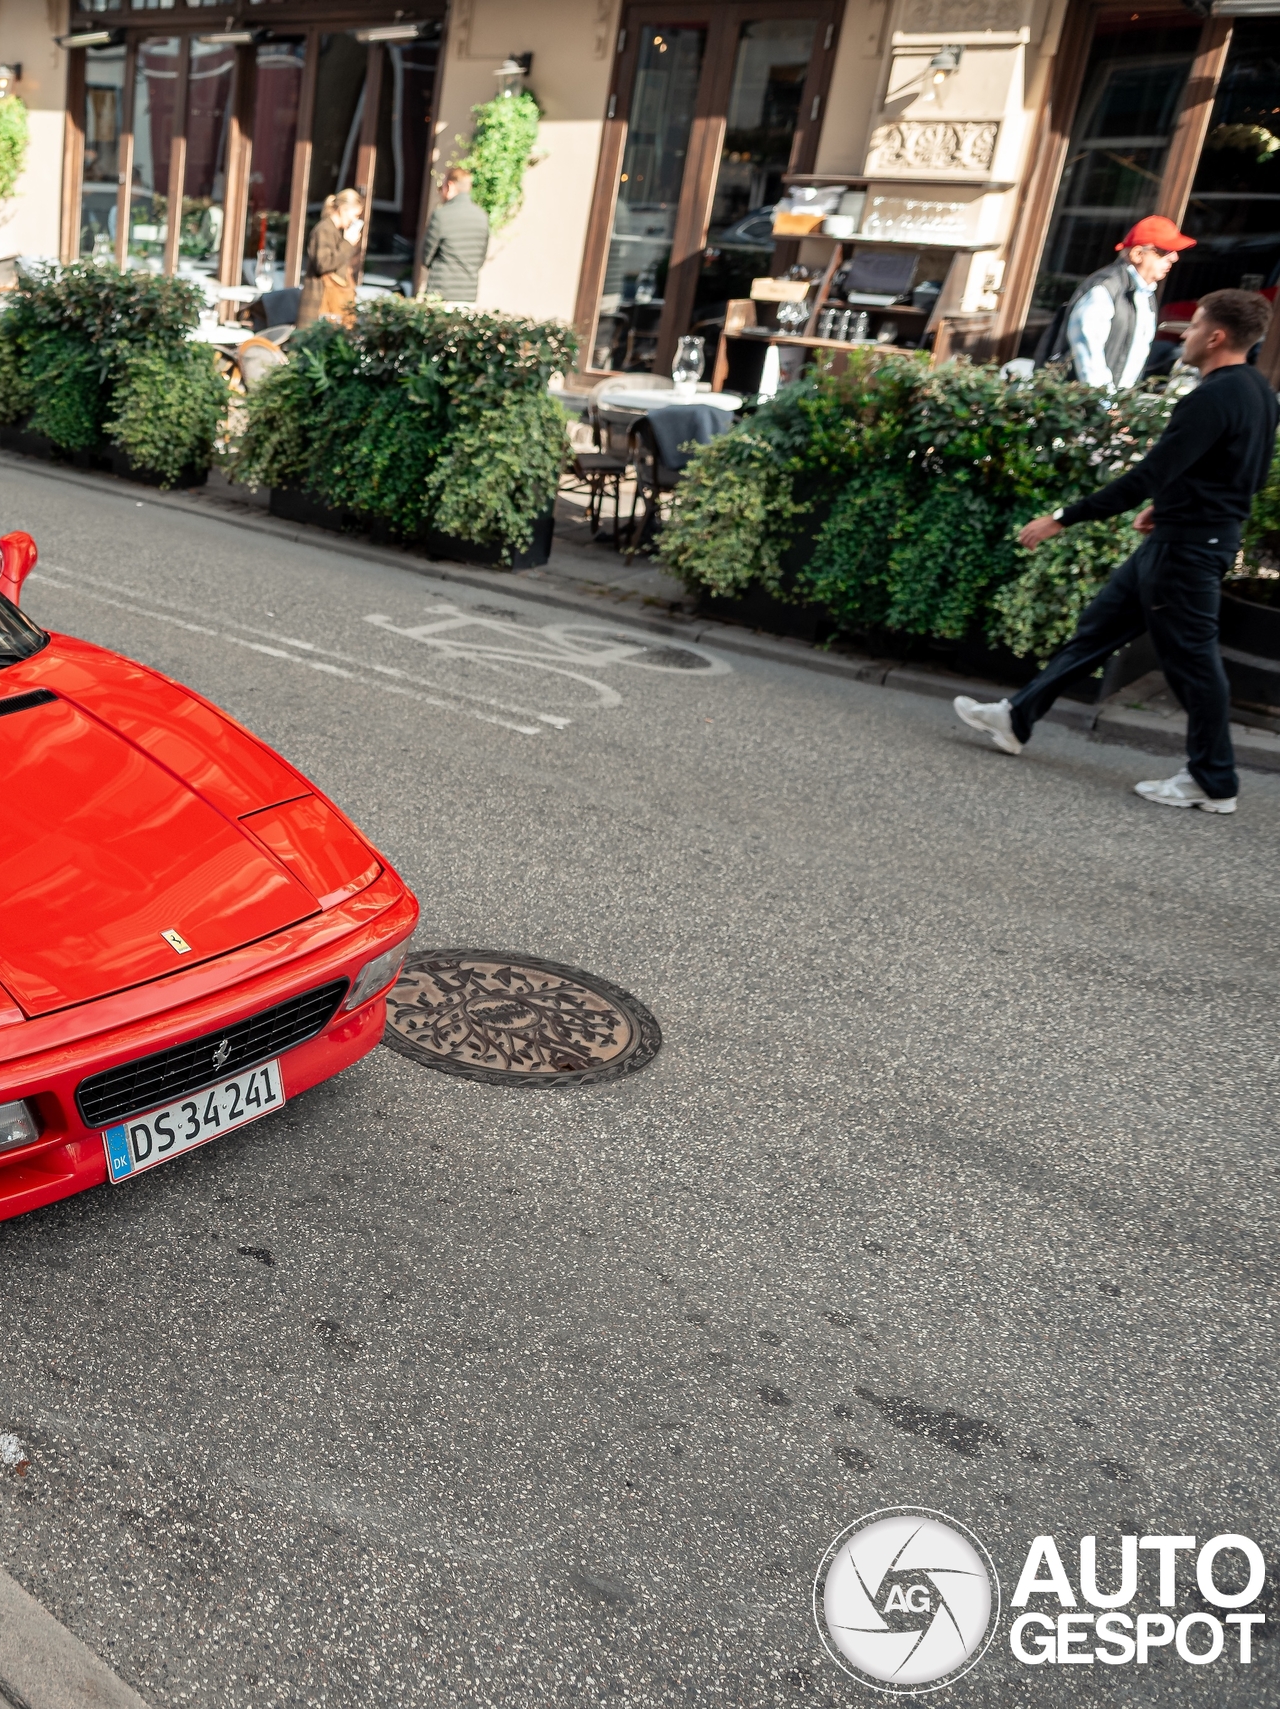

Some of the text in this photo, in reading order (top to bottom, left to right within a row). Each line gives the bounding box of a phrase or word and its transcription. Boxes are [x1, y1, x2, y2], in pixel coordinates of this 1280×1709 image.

[130, 1067, 276, 1163] DS 34 241
[113, 1155, 128, 1170] DK
